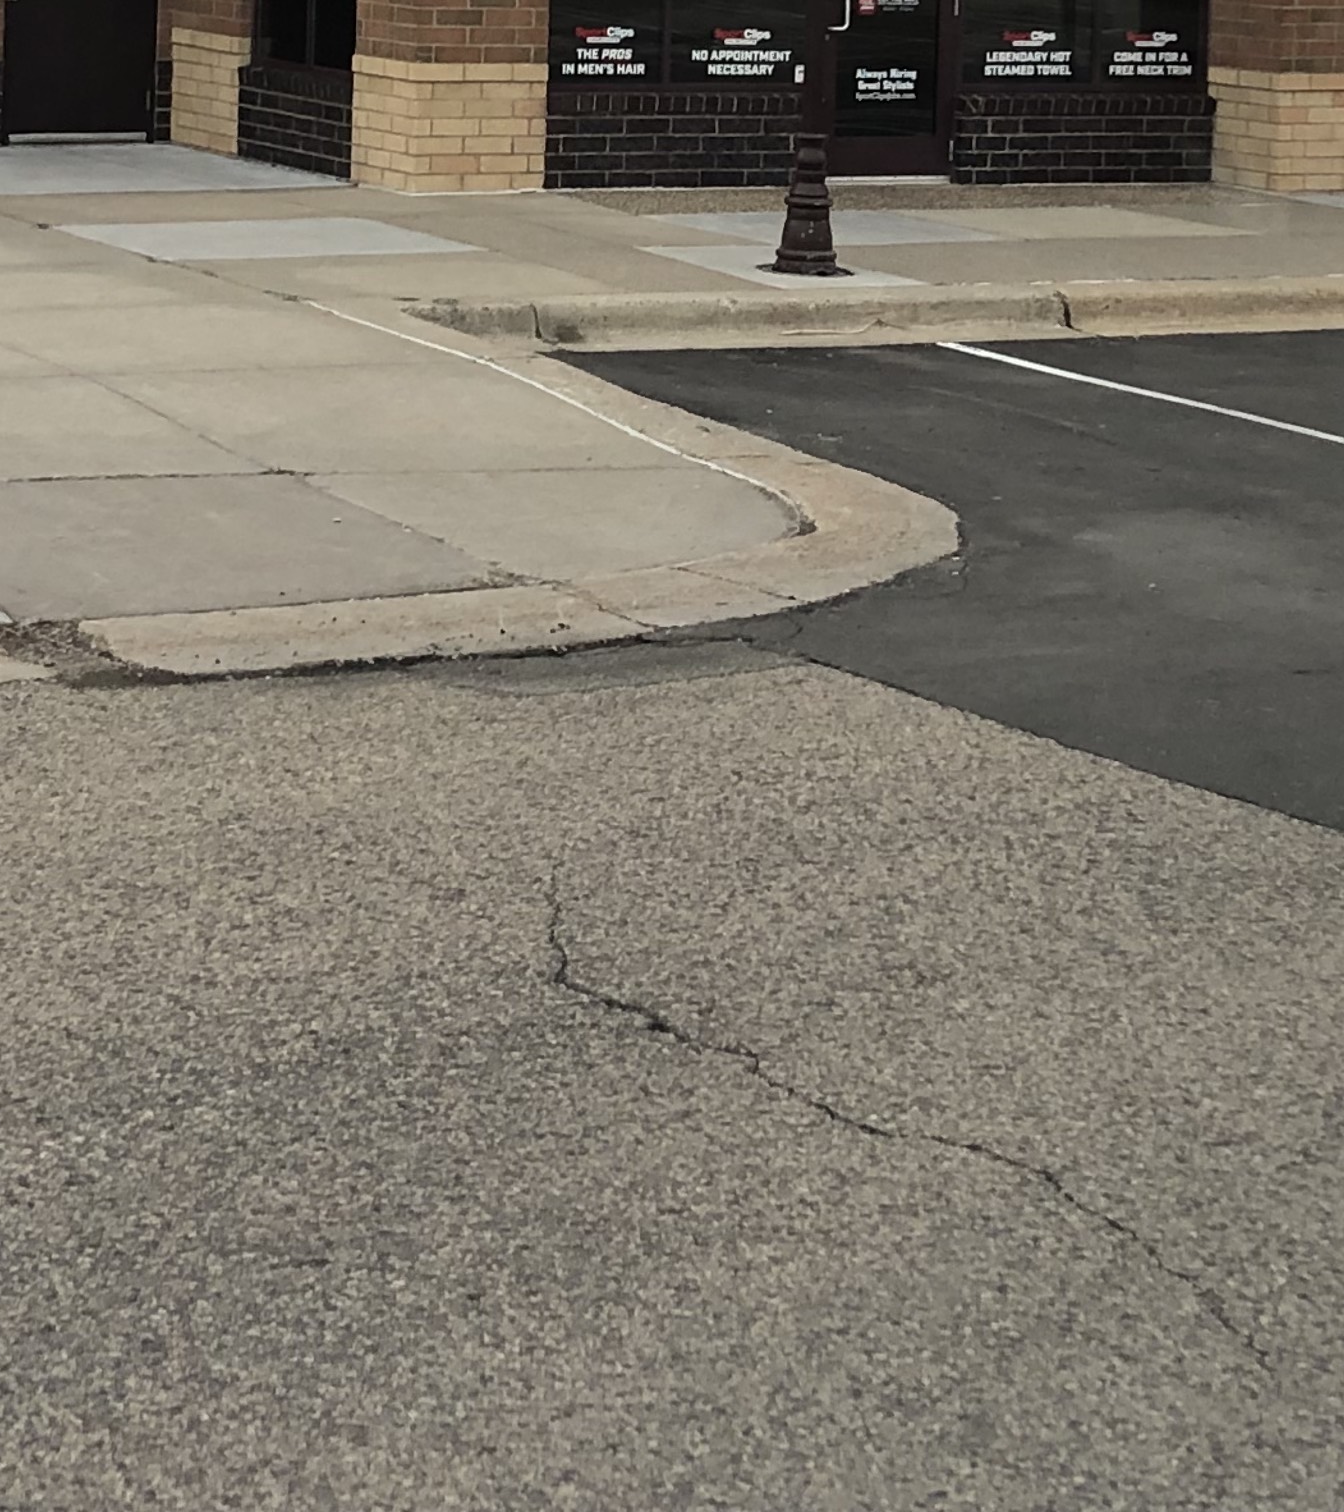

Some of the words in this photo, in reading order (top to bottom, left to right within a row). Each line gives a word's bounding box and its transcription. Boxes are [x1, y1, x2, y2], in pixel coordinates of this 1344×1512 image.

[576, 48, 599, 60] THE
[601, 48, 633, 60] PROS
[691, 49, 709, 61] NO
[710, 50, 792, 62] APPOINTMENT
[986, 51, 1048, 62] LEGENDARY
[1050, 51, 1072, 62] HOT
[562, 63, 575, 75] IN
[577, 63, 614, 75] MEN'S
[616, 63, 646, 75] HAIR
[707, 63, 774, 75] NECESSARY
[984, 64, 1035, 76] STEAMED
[1036, 64, 1072, 76] TOWEL
